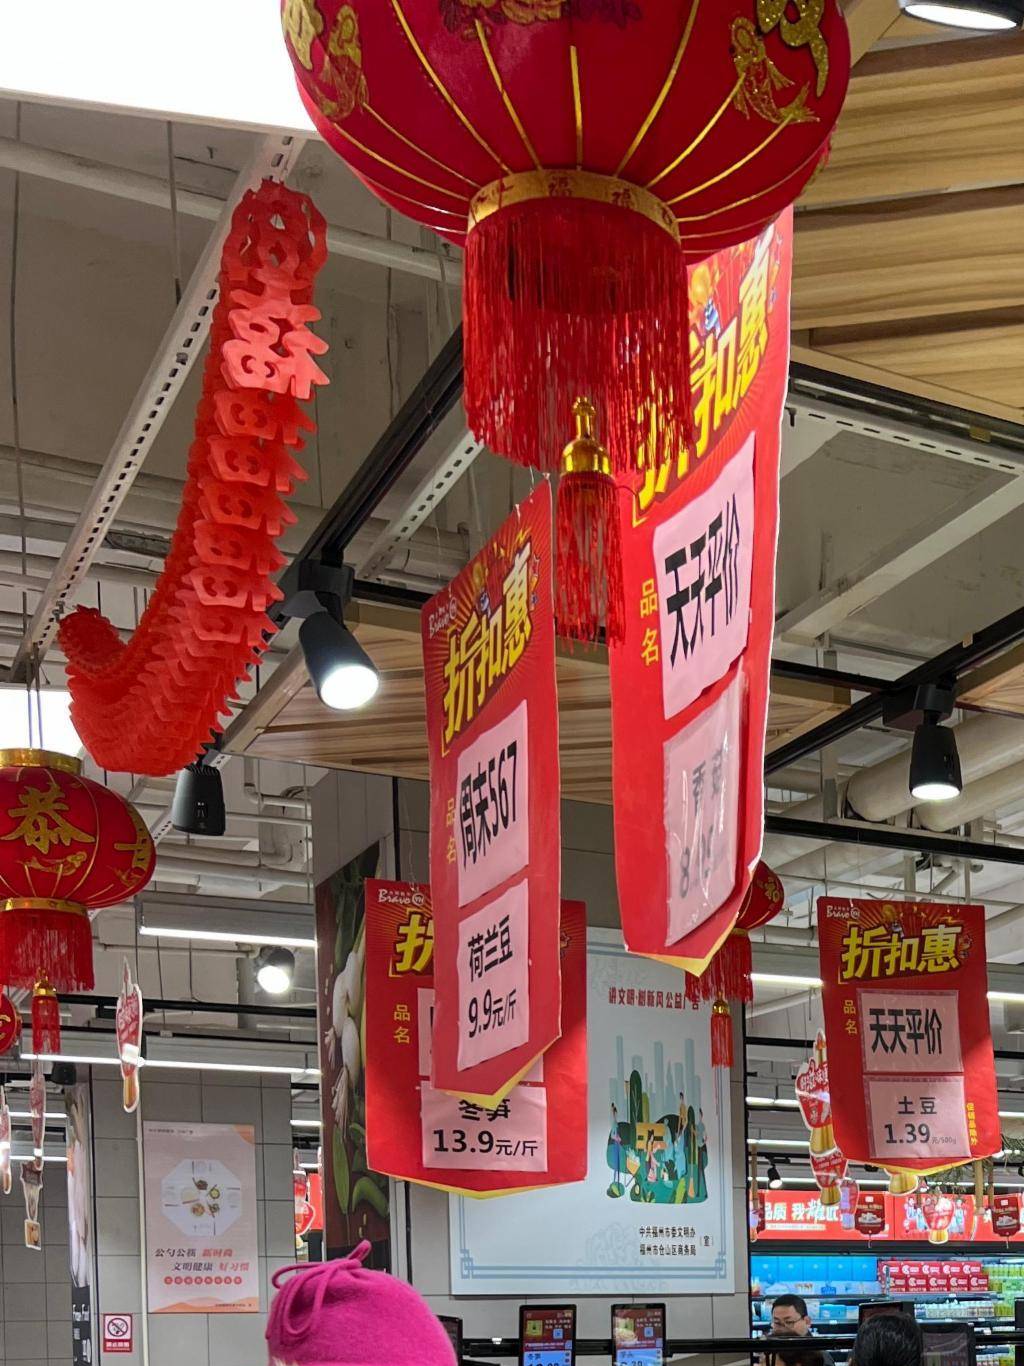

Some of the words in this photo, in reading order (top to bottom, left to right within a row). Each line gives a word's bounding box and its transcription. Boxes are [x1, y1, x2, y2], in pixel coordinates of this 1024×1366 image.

[664, 494, 740, 669] 天天平价
[443, 543, 532, 744] 折扣惠
[640, 578, 659, 666] 品名
[446, 797, 458, 864] 品名
[460, 741, 518, 872] 周末567
[468, 914, 513, 982] 荷兰豆
[841, 924, 963, 979] 折扣惠
[393, 1004, 411, 1044] 品名
[468, 988, 517, 1038] 9.9元/斤
[843, 1000, 858, 1034] 品名
[869, 1008, 942, 1055] 天天平价
[898, 1096, 937, 1114] 土豆
[433, 1129, 538, 1158] 13.9元/斤
